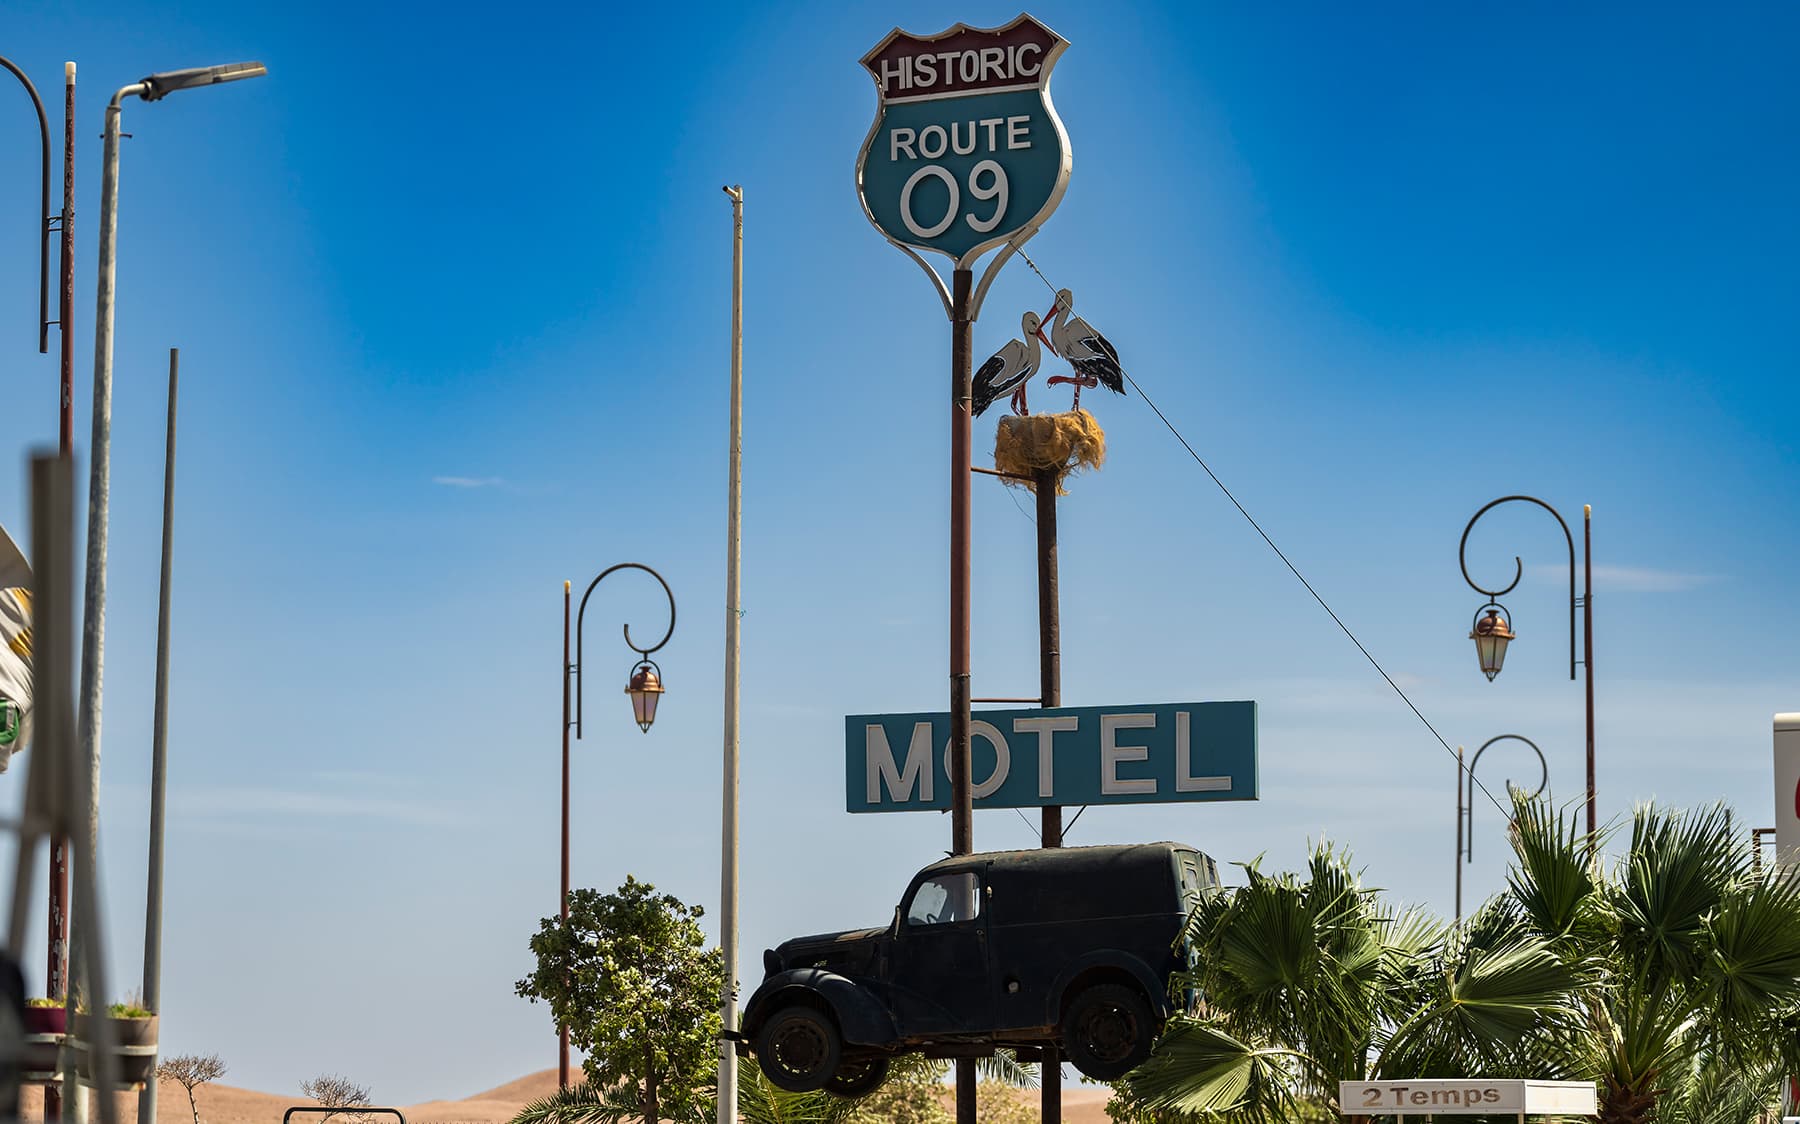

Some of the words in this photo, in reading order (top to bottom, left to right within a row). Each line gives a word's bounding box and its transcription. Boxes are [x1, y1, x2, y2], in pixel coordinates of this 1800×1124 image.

[880, 43, 1042, 92] HISTORIC
[890, 115, 1032, 161] ROUTE
[900, 160, 1009, 238] 09
[866, 711, 1232, 803] MOTEL
[1362, 1087, 1384, 1107] 2
[1390, 1086, 1501, 1108] Temps
